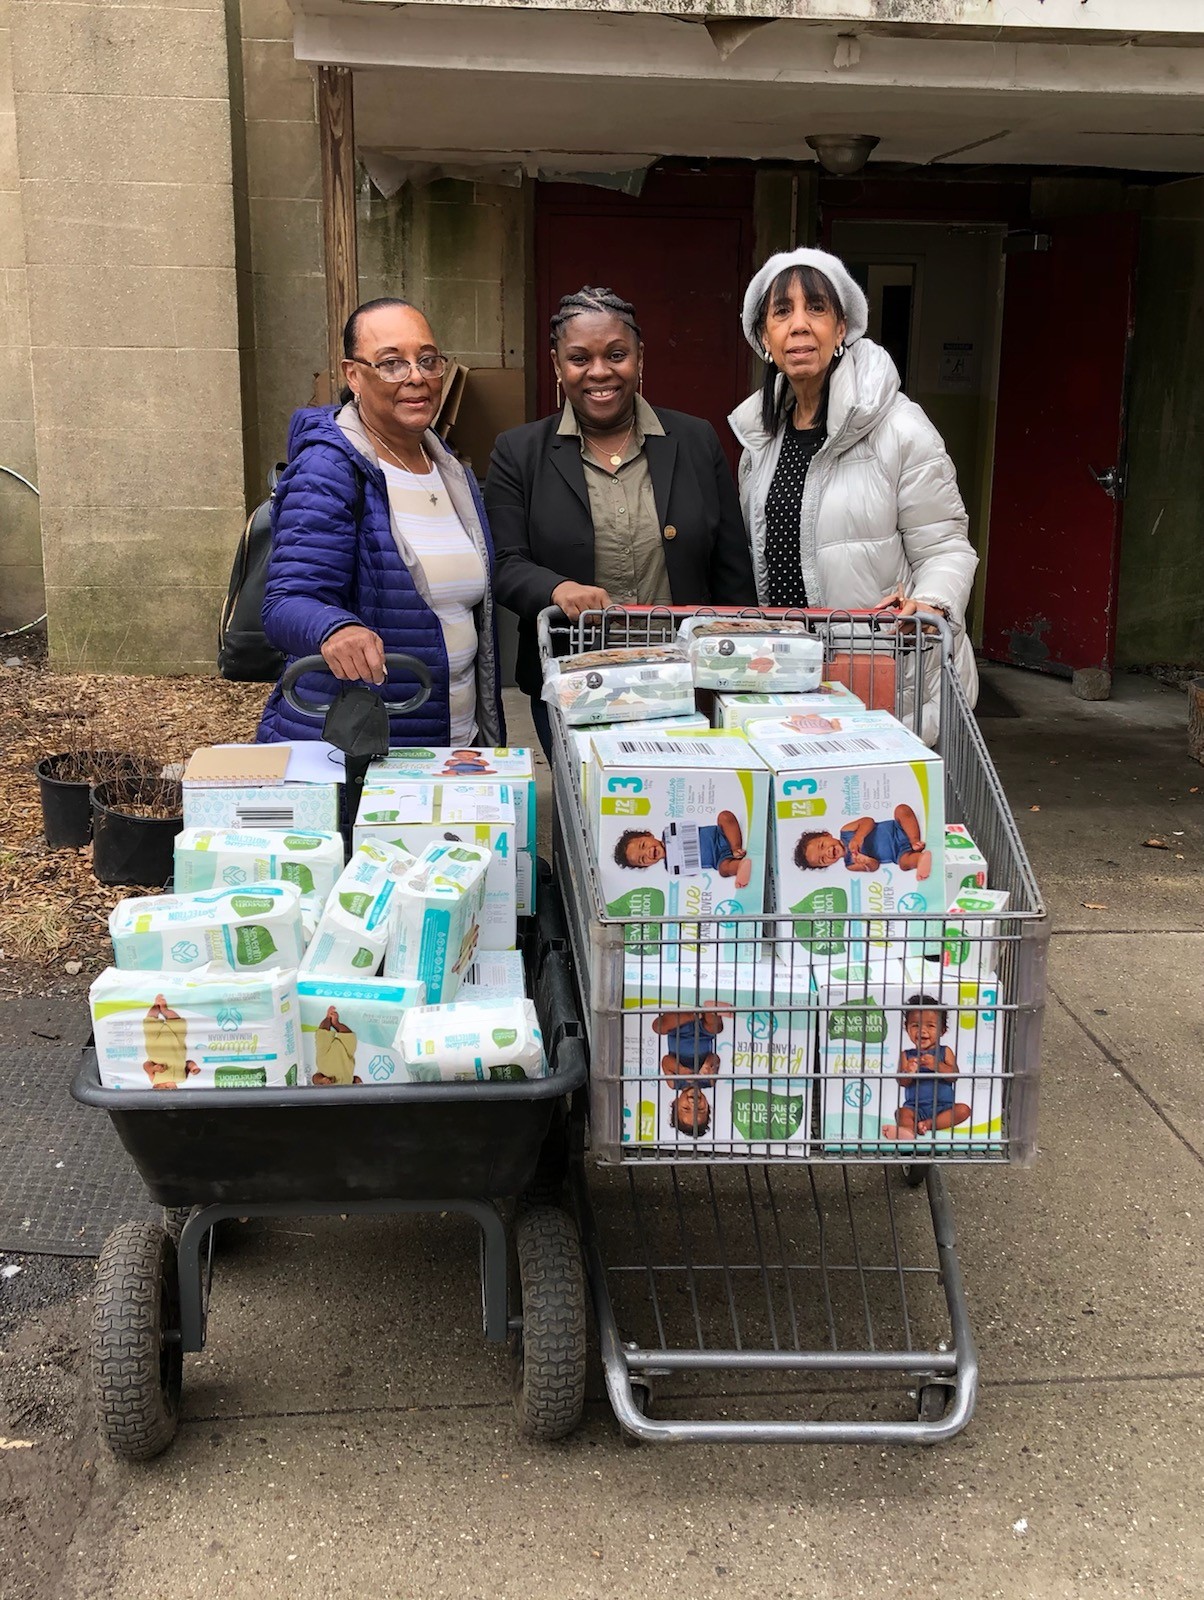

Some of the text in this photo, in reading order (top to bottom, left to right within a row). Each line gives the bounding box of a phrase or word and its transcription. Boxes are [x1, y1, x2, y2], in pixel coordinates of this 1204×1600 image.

[607, 776, 643, 794] 3
[664, 777, 676, 818] Sensitive
[675, 777, 686, 818] PROTECTION
[783, 777, 818, 796] 3
[840, 775, 851, 817] Sensitive
[850, 774, 861, 816] PROTECTION
[615, 800, 630, 814] 72
[792, 802, 806, 816] 72
[495, 831, 509, 858] 4
[701, 891, 712, 915] LOVER
[883, 886, 895, 910] LOVER
[628, 893, 642, 950] sevnth
[249, 926, 262, 961] seventh
[982, 990, 997, 1021] 3
[208, 1032, 253, 1041] HUMANITARIAN
[209, 1035, 258, 1055] future
[445, 1033, 481, 1042] PROTECTION
[730, 1047, 804, 1075] future
